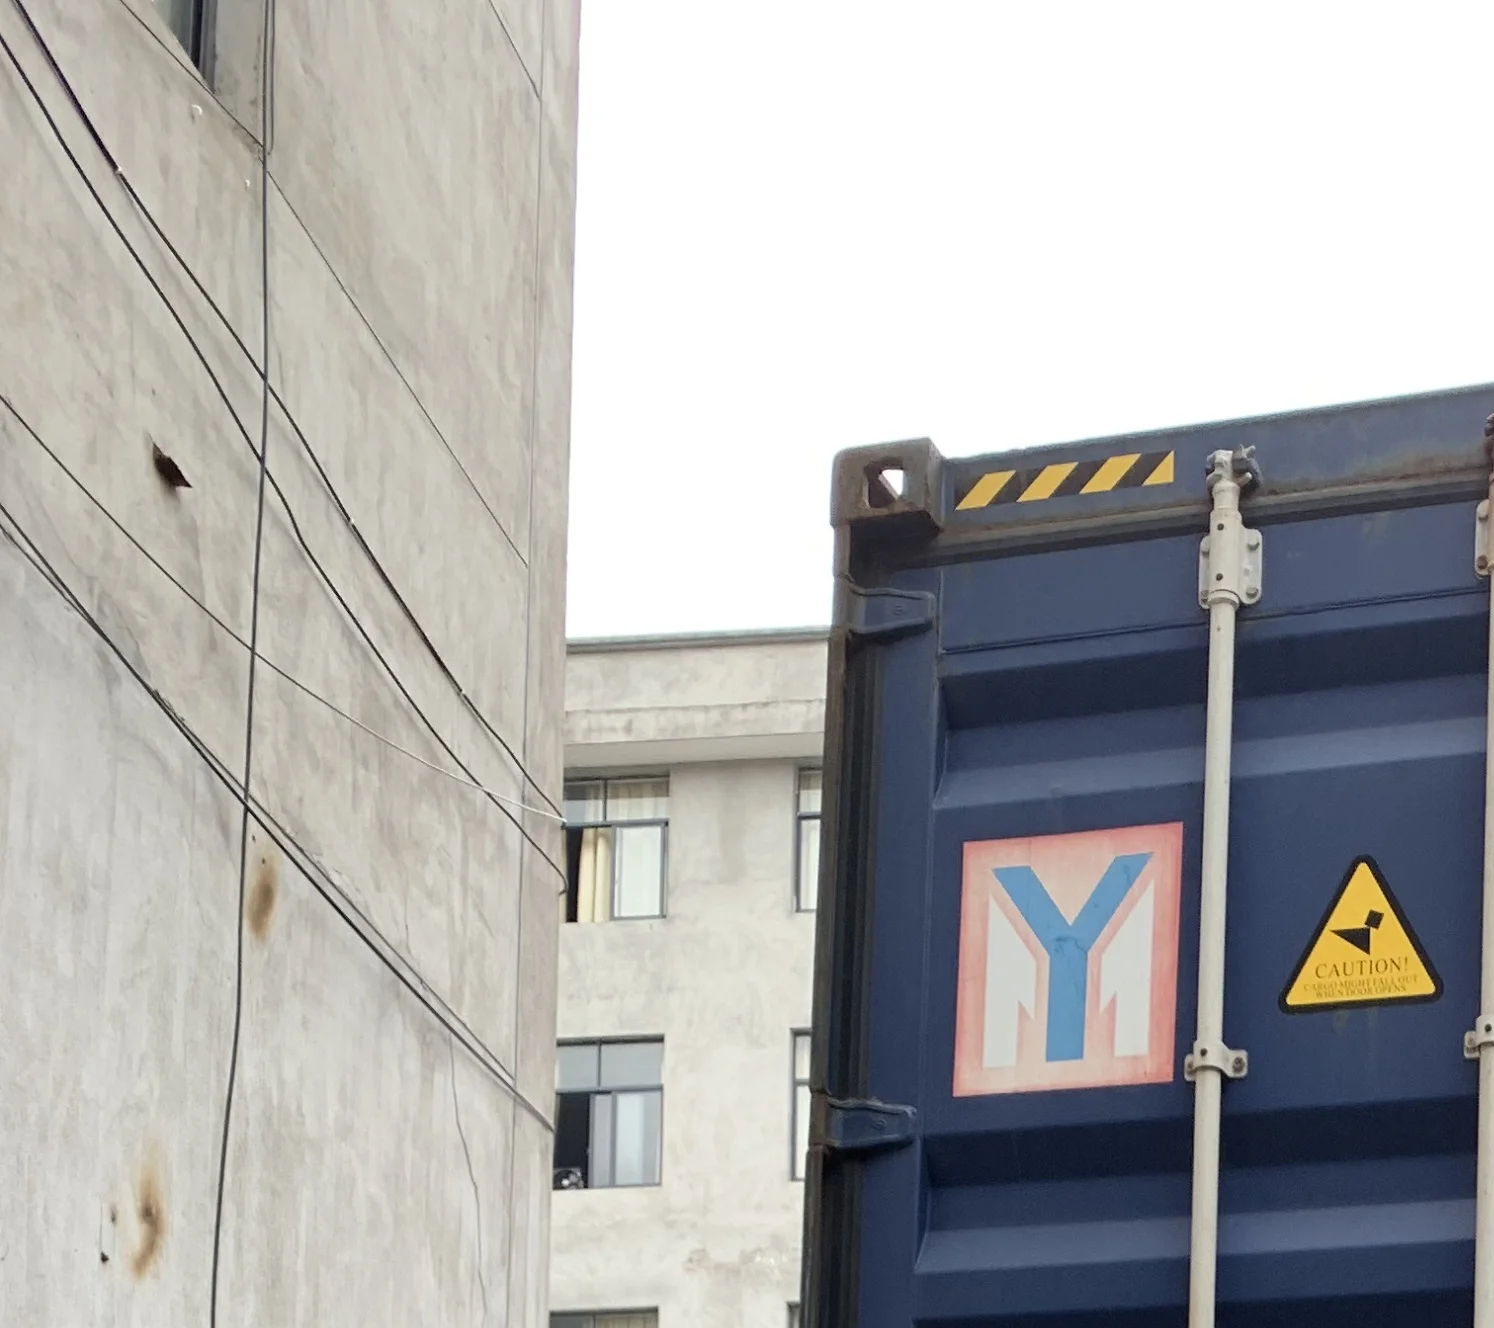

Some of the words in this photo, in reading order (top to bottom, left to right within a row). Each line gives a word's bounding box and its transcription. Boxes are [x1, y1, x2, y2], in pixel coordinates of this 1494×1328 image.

[1315, 956, 1408, 979] CAUTION!
[1303, 982, 1337, 992] CARGO
[1340, 979, 1370, 989] MIGHT
[1372, 977, 1397, 987] FALL
[1399, 974, 1418, 985] OUT
[1316, 988, 1344, 998] WHEN
[1346, 986, 1373, 997] DOOR
[1376, 984, 1407, 994] OPENS
